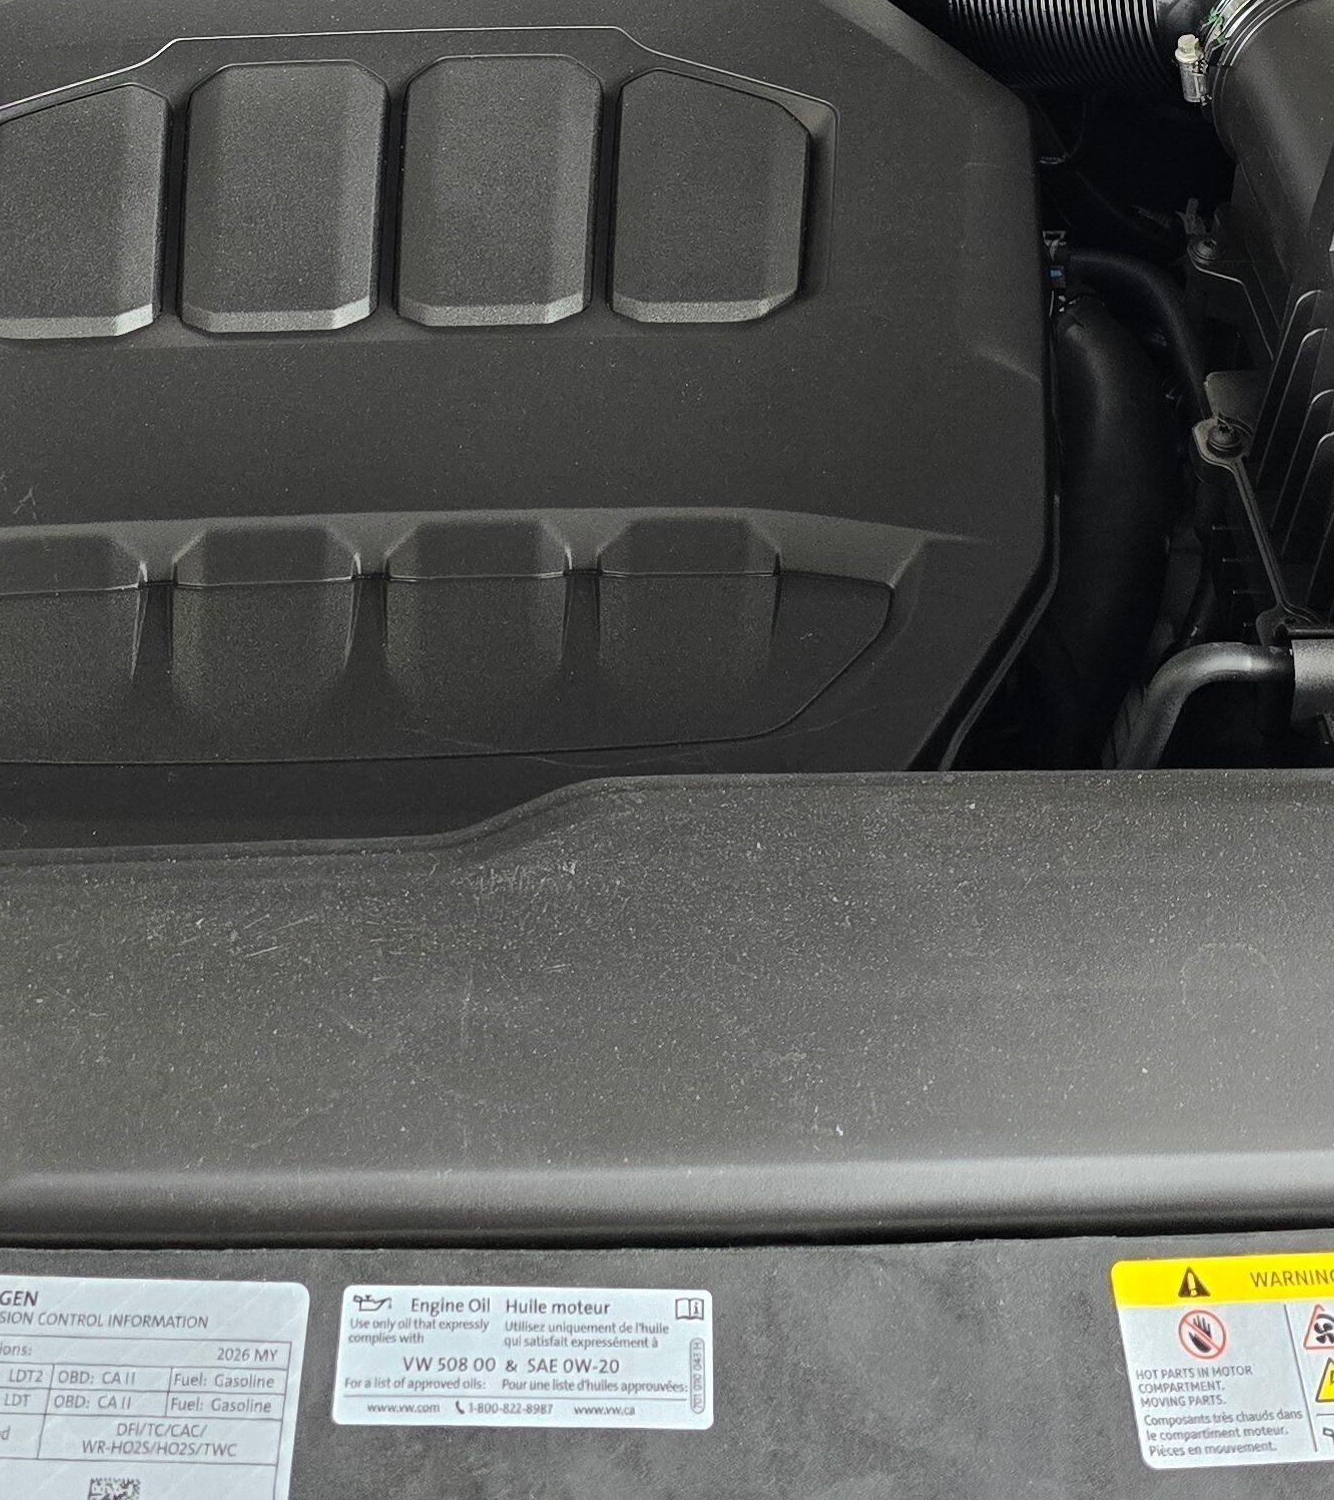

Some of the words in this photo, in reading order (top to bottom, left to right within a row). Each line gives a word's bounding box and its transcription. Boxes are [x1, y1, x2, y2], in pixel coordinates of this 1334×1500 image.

[411, 1298, 464, 1317] Engine
[468, 1298, 490, 1313] Oil
[506, 1299, 547, 1314] Huile
[552, 1302, 610, 1315] moteur
[38, 1312, 103, 1328] CONTROL
[108, 1315, 209, 1329] INFORMATION
[350, 1319, 370, 1329] Use
[372, 1319, 395, 1331] only
[397, 1319, 411, 1329] oil
[414, 1319, 436, 1330] that
[438, 1319, 489, 1333] expressly
[505, 1321, 545, 1333] Utilisez
[549, 1322, 616, 1336] uniquement
[619, 1322, 632, 1334] de
[348, 1332, 397, 1346] complies
[399, 1333, 424, 1343] with
[504, 1337, 521, 1349] qui
[524, 1336, 568, 1348] satisfait
[571, 1336, 648, 1350] expressément
[217, 1348, 250, 1361] 2026
[254, 1349, 279, 1361] MY
[403, 1357, 433, 1372] VW
[438, 1357, 468, 1372] 508
[473, 1357, 496, 1372] 00
[505, 1360, 518, 1372] &
[527, 1358, 558, 1373] SAE
[563, 1359, 620, 1374] 0W-20
[1136, 1369, 1159, 1380] HOT
[1161, 1368, 1192, 1379] PARTS
[1194, 1367, 1209, 1377] IN
[1212, 1365, 1253, 1377] MOTOR
[8, 1369, 44, 1383] LDT2
[58, 1370, 94, 1385] OBD:
[102, 1371, 123, 1385] CA
[174, 1373, 207, 1387] Fuel:
[214, 1374, 275, 1388] Gasoline
[345, 1378, 362, 1389] For
[374, 1378, 392, 1388] list
[394, 1378, 406, 1388] of
[409, 1378, 460, 1391] approved
[502, 1378, 527, 1391] Pour
[529, 1381, 550, 1391] une
[552, 1379, 574, 1391] liste
[621, 1380, 688, 1394] approuvées:
[1138, 1381, 1226, 1394] COMPARTMENT.
[4, 1394, 32, 1407] LDT
[54, 1395, 90, 1409] OBD:
[98, 1396, 119, 1409] CA
[171, 1398, 204, 1411] Fuel:
[211, 1398, 271, 1413] Gasoline
[367, 1404, 440, 1413] www.vw.com
[468, 1403, 554, 1415] 1-800-822-8987
[573, 1405, 636, 1415] www.vw.ca
[1141, 1396, 1187, 1408] MOVING
[1143, 1415, 1211, 1428] Composants
[1213, 1412, 1233, 1423] très
[1235, 1410, 1274, 1422] chauds
[1276, 1409, 1303, 1420] dans
[116, 1423, 208, 1437] DFI/TC/CAC/
[1160, 1427, 1241, 1441] compartiment
[1149, 1444, 1186, 1457] Pièces
[1188, 1444, 1203, 1455] en
[1204, 1441, 1277, 1455] mouvement.
